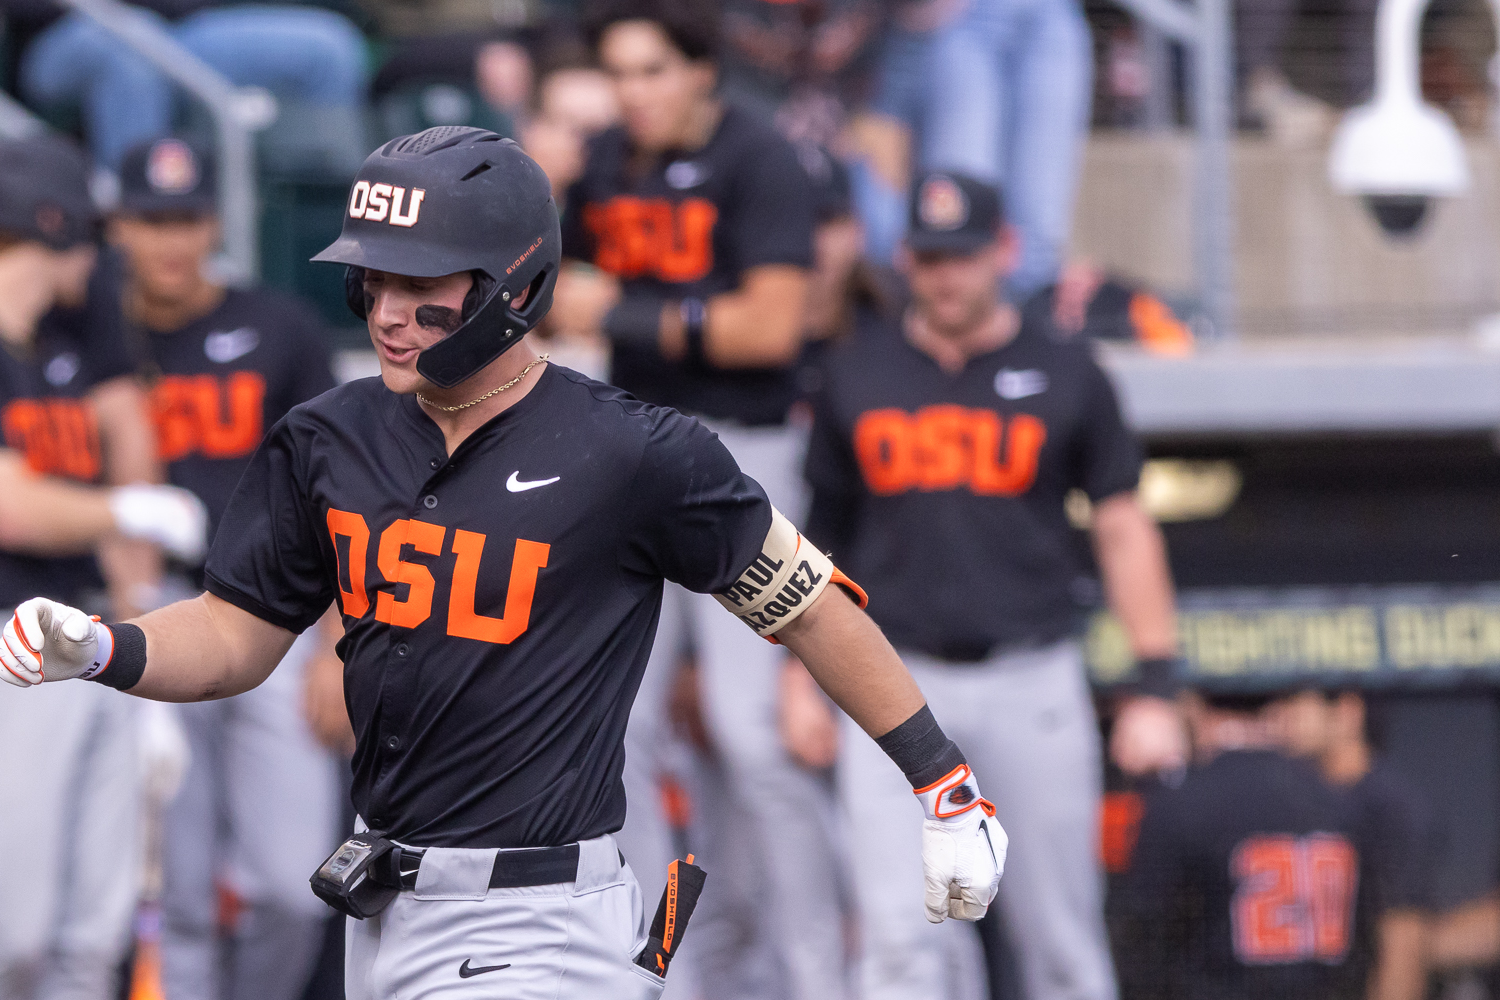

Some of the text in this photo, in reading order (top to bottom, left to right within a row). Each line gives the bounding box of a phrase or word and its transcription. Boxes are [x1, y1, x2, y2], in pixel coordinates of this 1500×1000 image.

[349, 180, 426, 228] OSU
[506, 237, 543, 275] EVOSHIELD
[148, 371, 268, 463] SU
[853, 403, 1047, 497] OSU
[326, 507, 551, 645] OSU
[722, 552, 784, 607] PAUL
[740, 560, 823, 633] AZQUEZ
[79, 661, 101, 678] SU
[667, 873, 677, 941] EVOSHIELD
